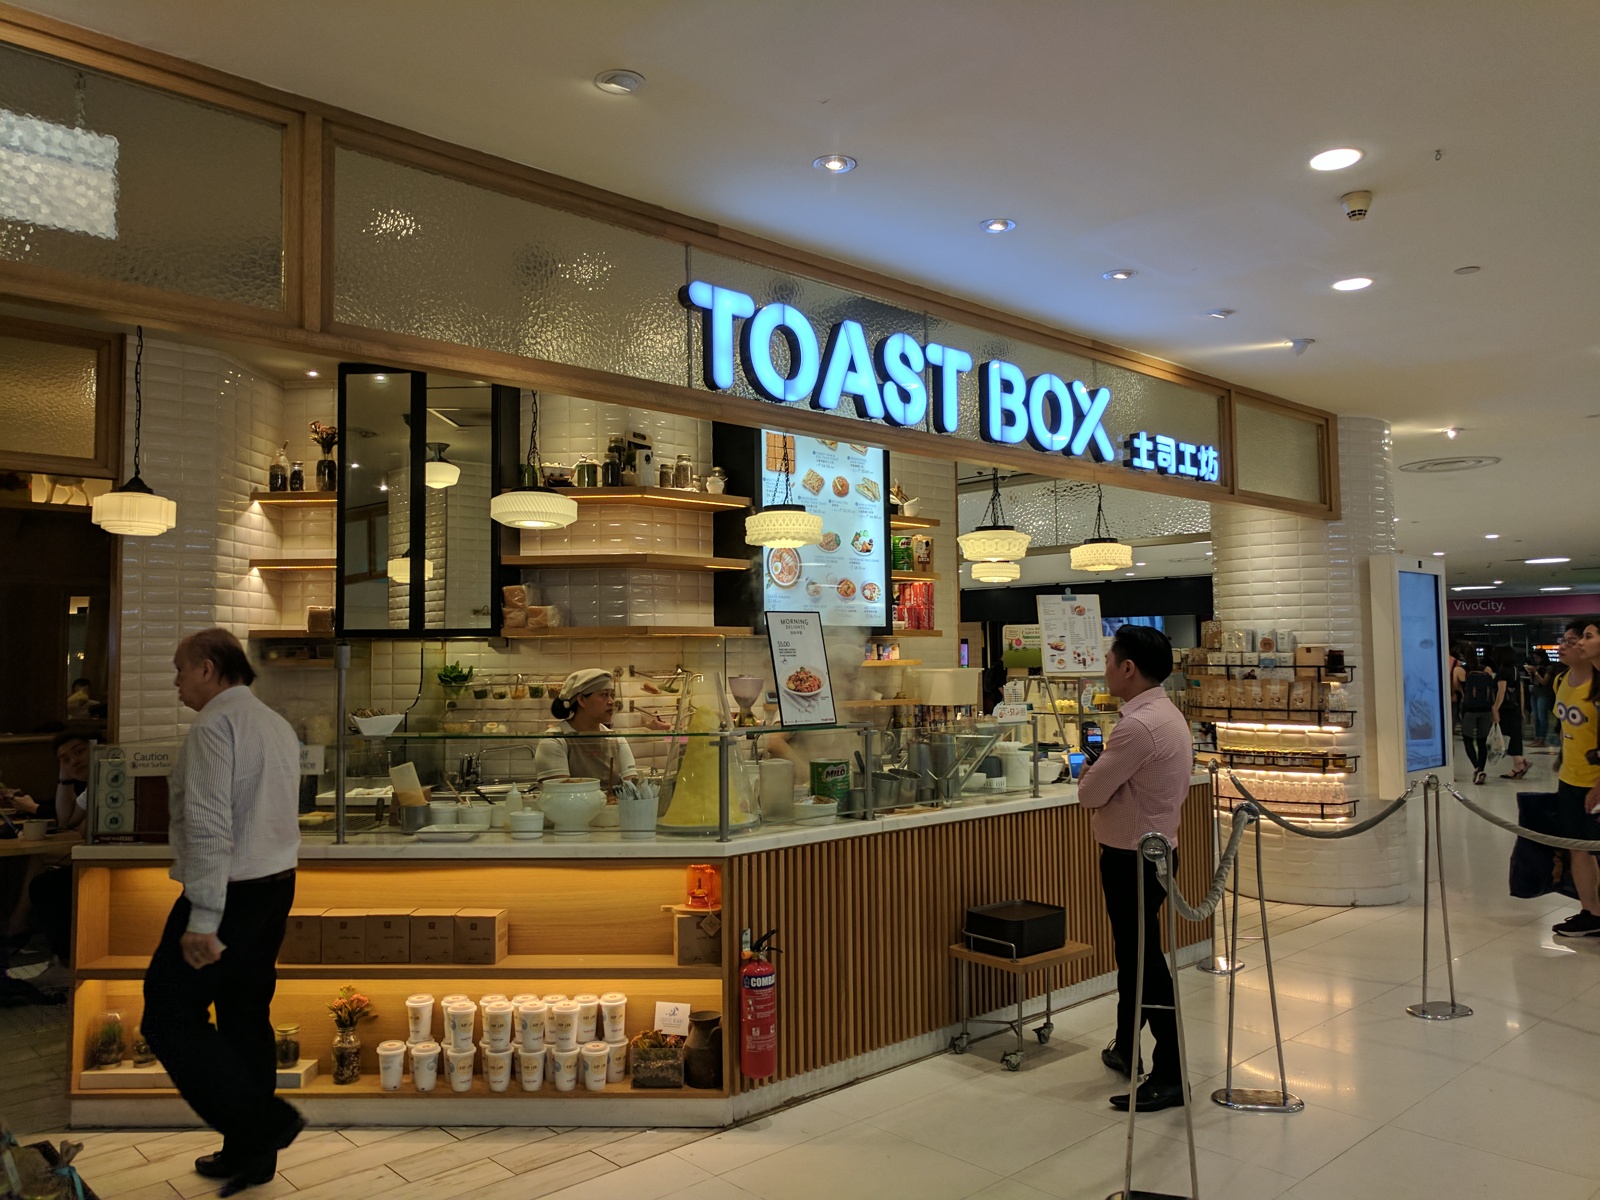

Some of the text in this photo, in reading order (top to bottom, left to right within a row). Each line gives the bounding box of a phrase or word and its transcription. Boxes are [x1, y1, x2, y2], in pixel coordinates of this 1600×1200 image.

[685, 280, 1115, 462] TOAST BOX
[1130, 431, 1220, 482] 土司工坊
[1453, 600, 1506, 613] VivoCity.
[133, 752, 169, 762] Caution
[825, 769, 845, 779] MILO
